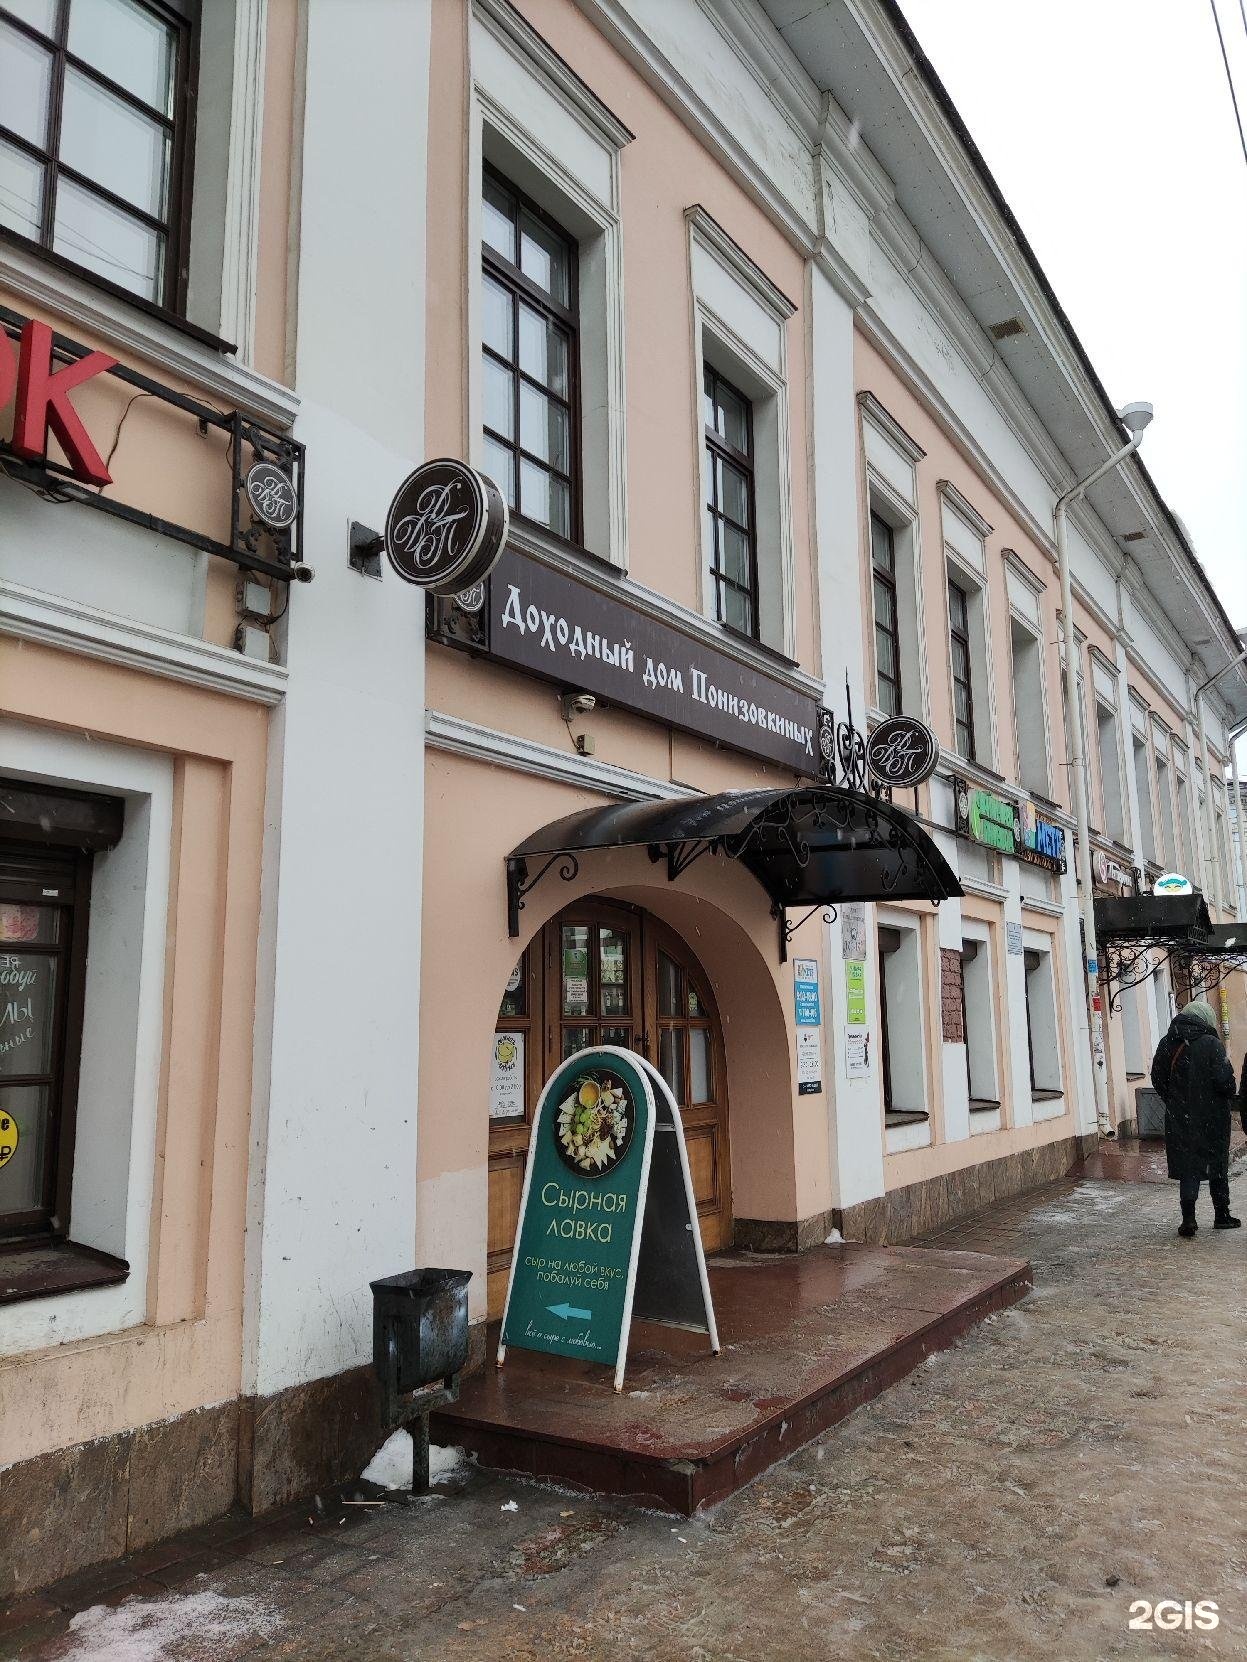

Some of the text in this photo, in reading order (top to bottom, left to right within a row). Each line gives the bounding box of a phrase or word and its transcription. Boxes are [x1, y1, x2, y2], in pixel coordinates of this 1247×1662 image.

[0, 318, 120, 487] К
[501, 583, 635, 673] Доходный
[643, 656, 684, 695] дом
[690, 666, 814, 758] Понизовкиных
[541, 1182, 627, 1215] Сырная
[546, 1216, 612, 1243] лавка
[525, 1256, 546, 1270] сыр
[548, 1260, 561, 1270] на
[564, 1260, 598, 1274] любой
[537, 1271, 609, 1291] побалуй себя
